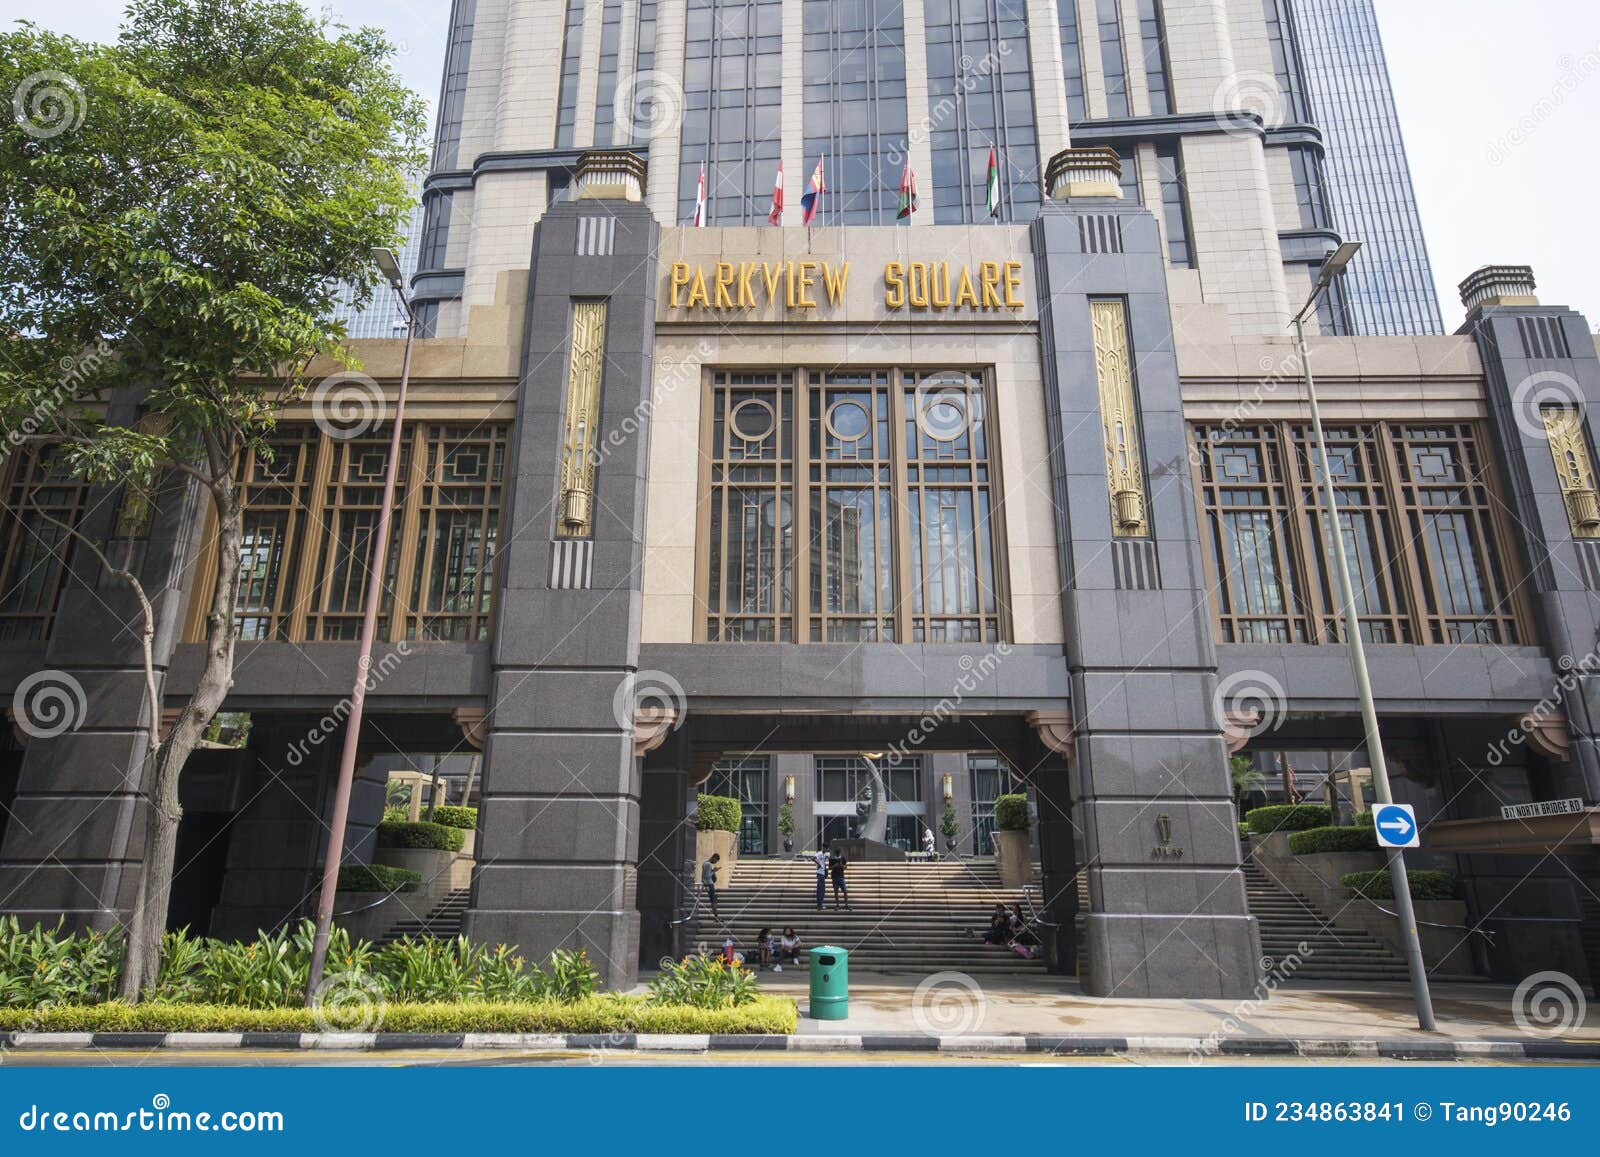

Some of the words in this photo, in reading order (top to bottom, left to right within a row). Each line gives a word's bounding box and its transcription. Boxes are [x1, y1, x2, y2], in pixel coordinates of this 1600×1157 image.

[669, 261, 850, 309] PARKVIEW
[884, 261, 1025, 309] SQUARE
[1516, 804, 1541, 817] NORTH
[1541, 800, 1569, 815] BRIDGE
[1569, 799, 1581, 812] RD
